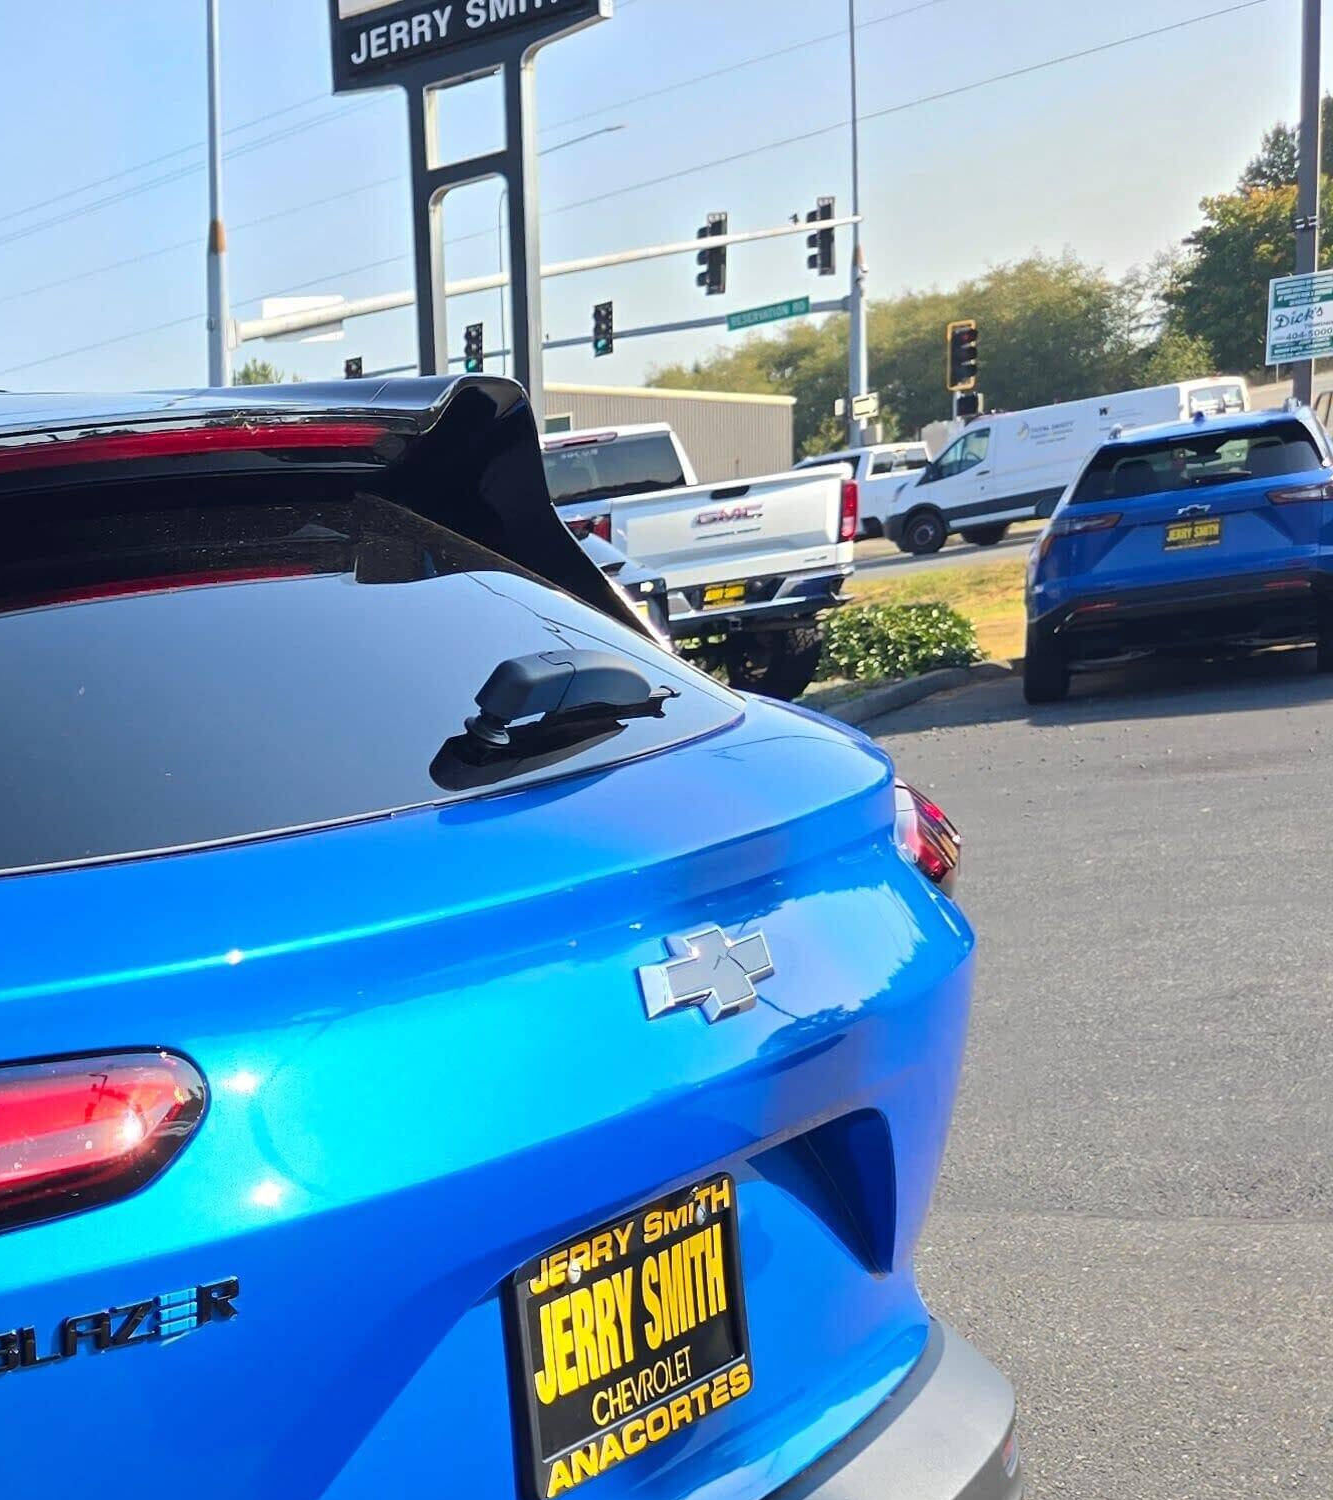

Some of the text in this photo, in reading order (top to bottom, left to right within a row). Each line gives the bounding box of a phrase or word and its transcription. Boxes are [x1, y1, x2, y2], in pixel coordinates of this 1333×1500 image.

[351, 0, 558, 65] JERRY SMI
[693, 503, 764, 526] GMC
[1194, 522, 1220, 538] SMITH
[529, 1179, 731, 1296] JERRY SMITH
[534, 1222, 728, 1406] JERRY SMITH
[591, 1346, 693, 1427] CHEVROLET
[546, 1363, 752, 1498] ANACORTES
